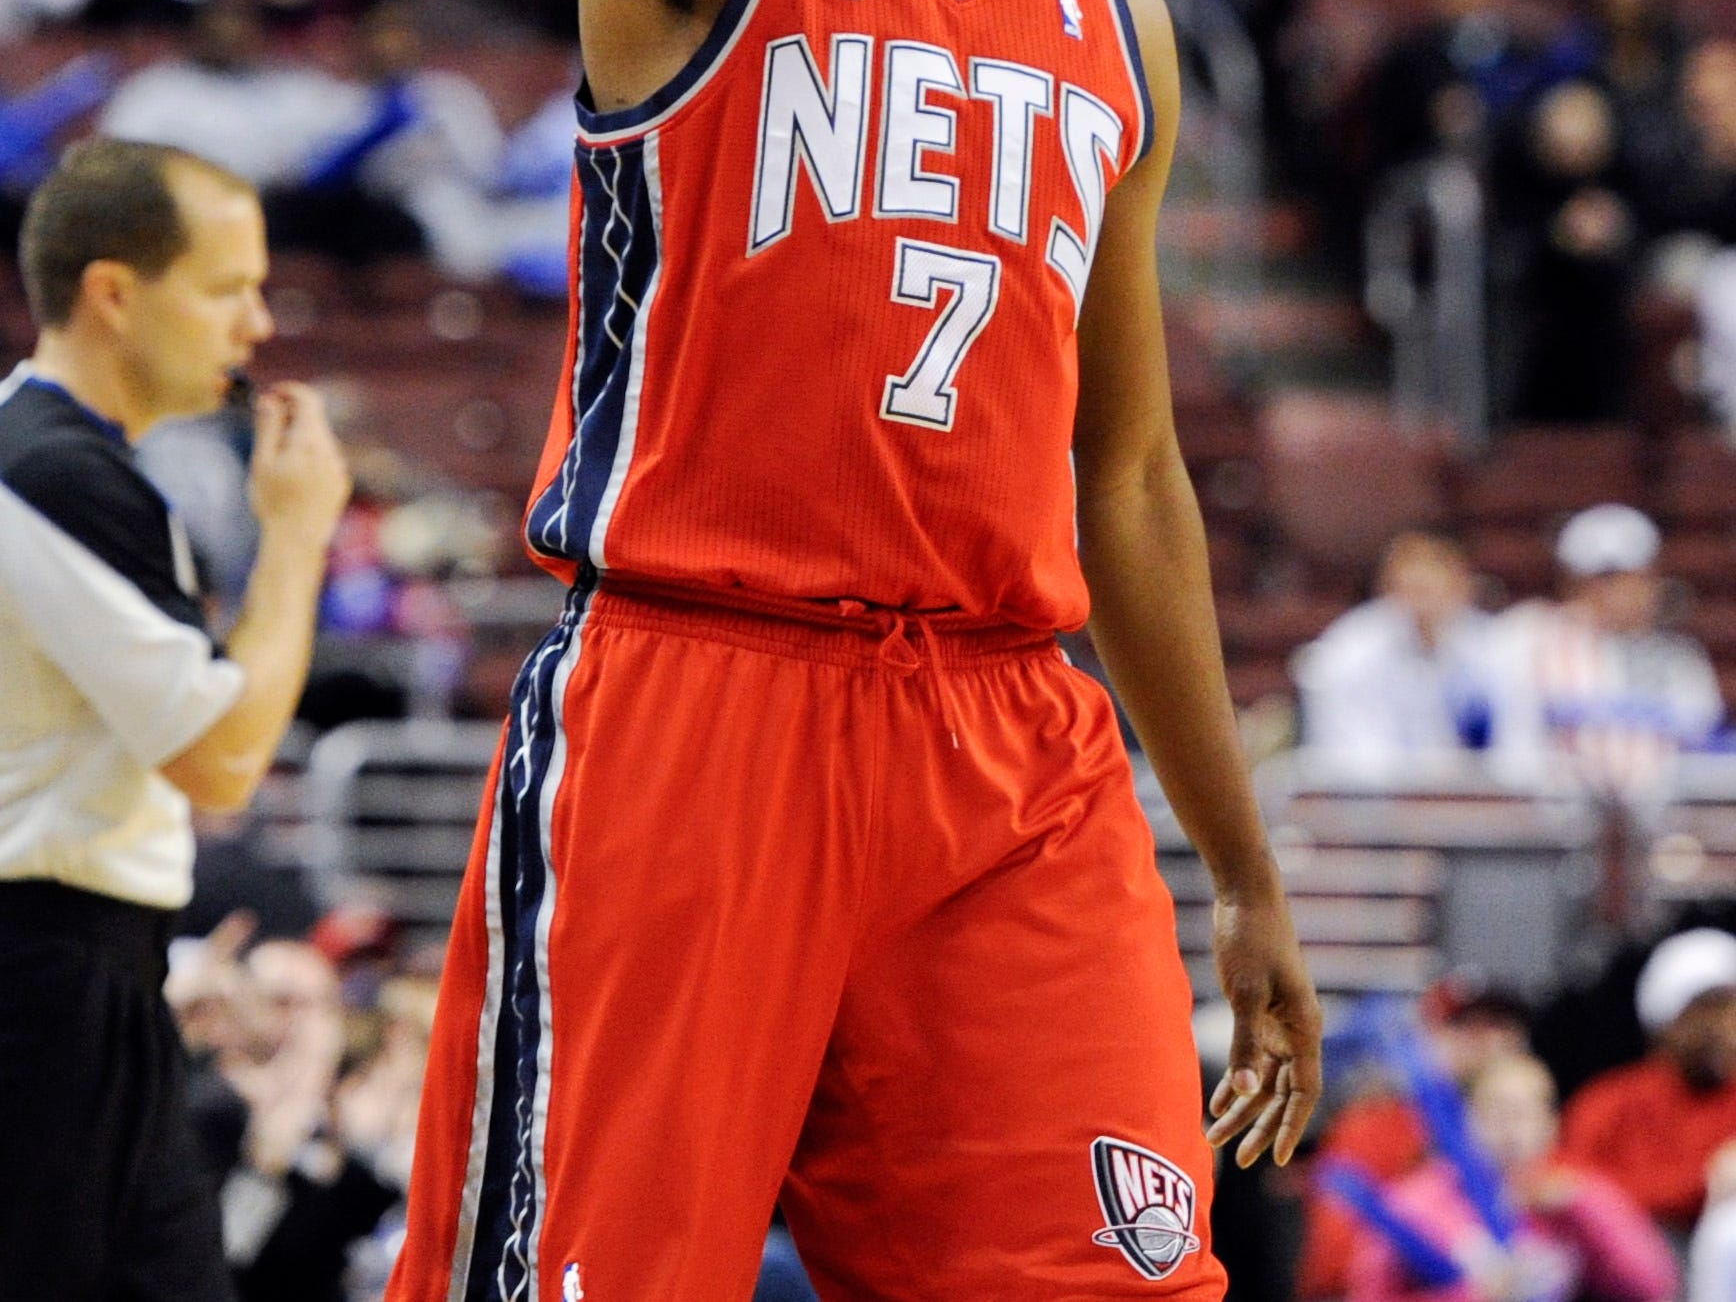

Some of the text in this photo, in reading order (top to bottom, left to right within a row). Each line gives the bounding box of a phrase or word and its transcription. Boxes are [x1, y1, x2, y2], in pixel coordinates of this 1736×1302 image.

[745, 33, 1123, 330] NETS
[880, 236, 1000, 432] 7
[1111, 1149, 1191, 1230] NETS
